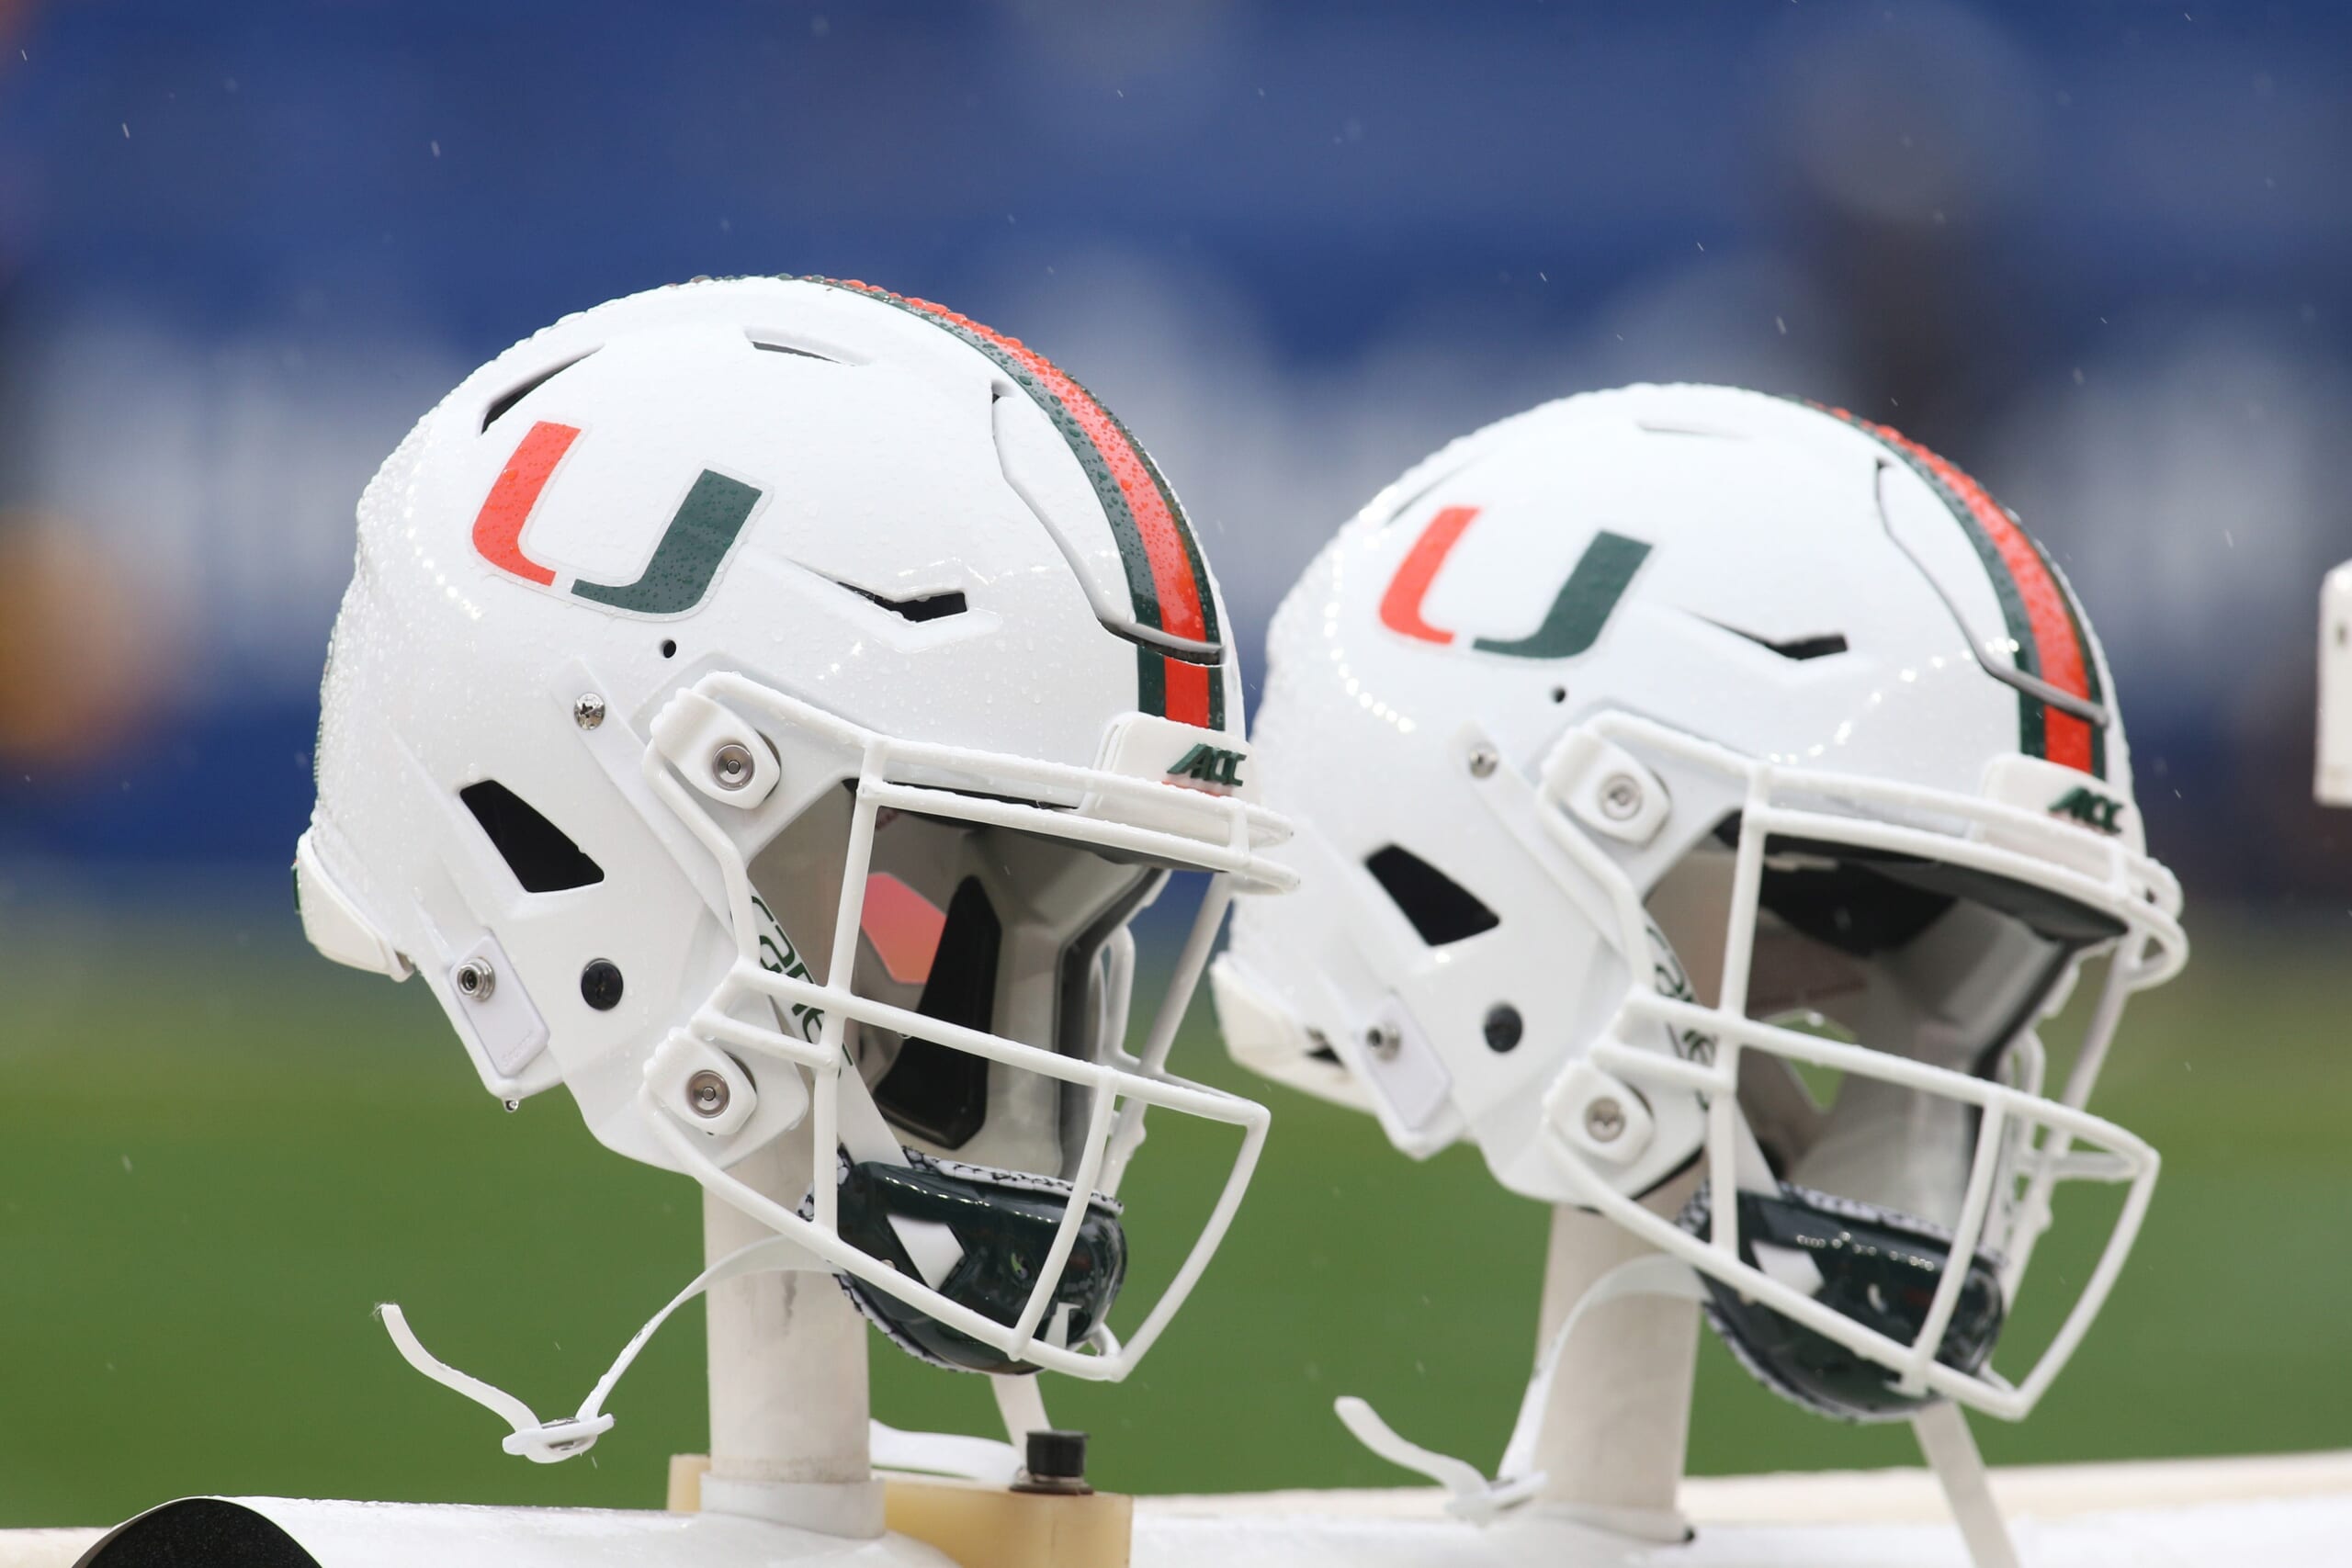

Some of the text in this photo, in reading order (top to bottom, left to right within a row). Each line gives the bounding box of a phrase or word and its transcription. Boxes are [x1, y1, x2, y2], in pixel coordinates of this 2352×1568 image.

[472, 421, 763, 614] U
[1379, 506, 1653, 660] U
[1166, 743, 1247, 786] ACC
